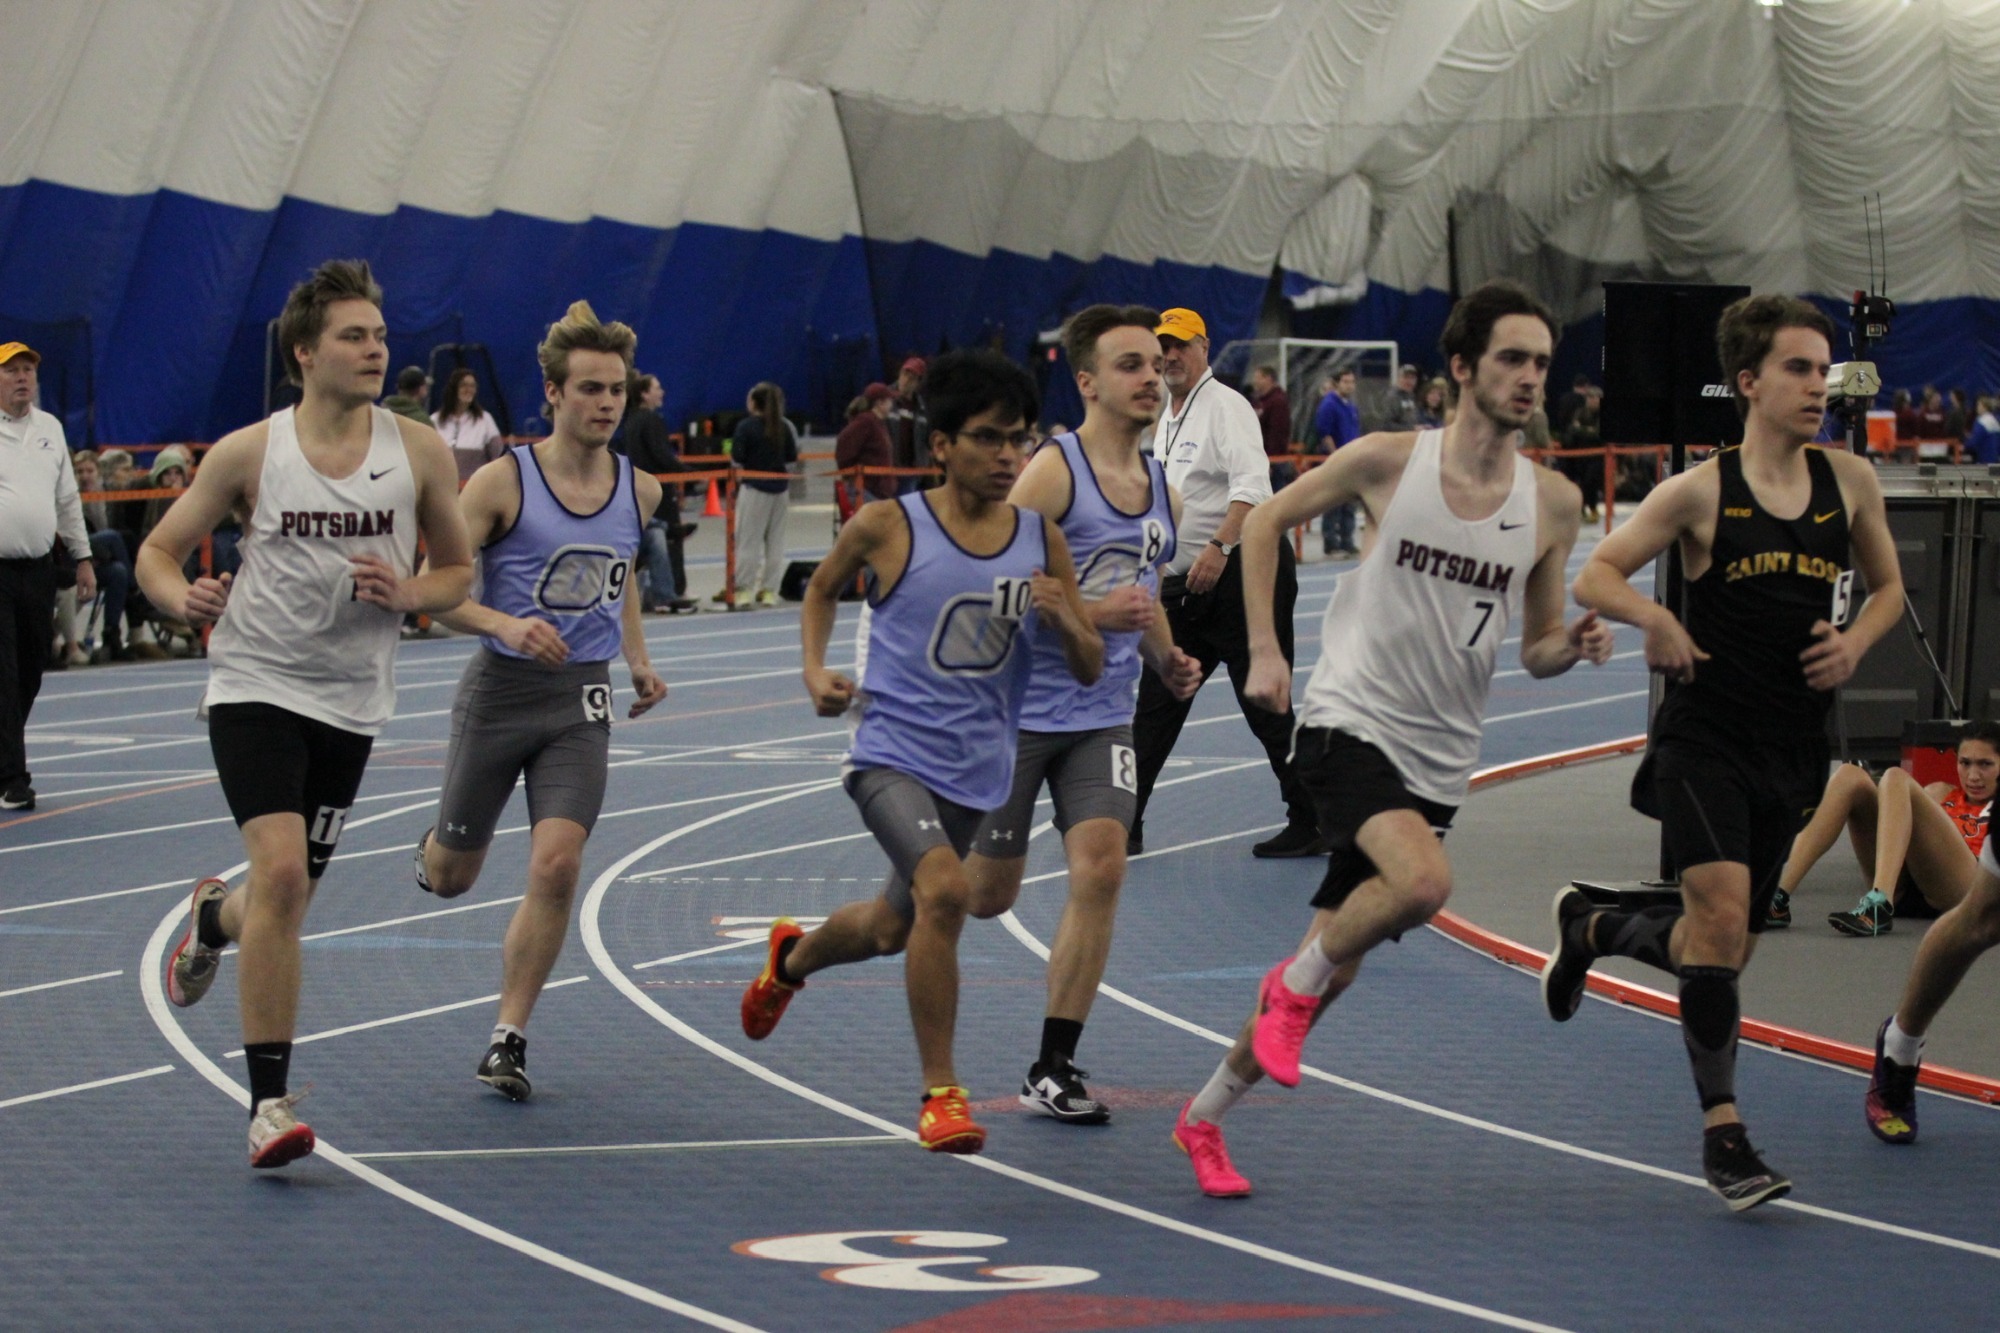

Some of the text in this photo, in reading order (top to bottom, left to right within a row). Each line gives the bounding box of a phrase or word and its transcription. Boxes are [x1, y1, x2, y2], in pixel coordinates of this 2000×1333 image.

[1701, 384, 1735, 398] GIL
[281, 509, 394, 537] POTSDAM
[1146, 522, 1161, 563] 8
[607, 561, 628, 601] 9
[1396, 538, 1514, 593] POTSDAM
[1726, 551, 1791, 582] SAINT
[997, 579, 1031, 617] 10
[1837, 574, 1851, 622] 5
[1467, 601, 1495, 647] 7
[587, 687, 611, 722] 9
[1119, 748, 1136, 789] 8
